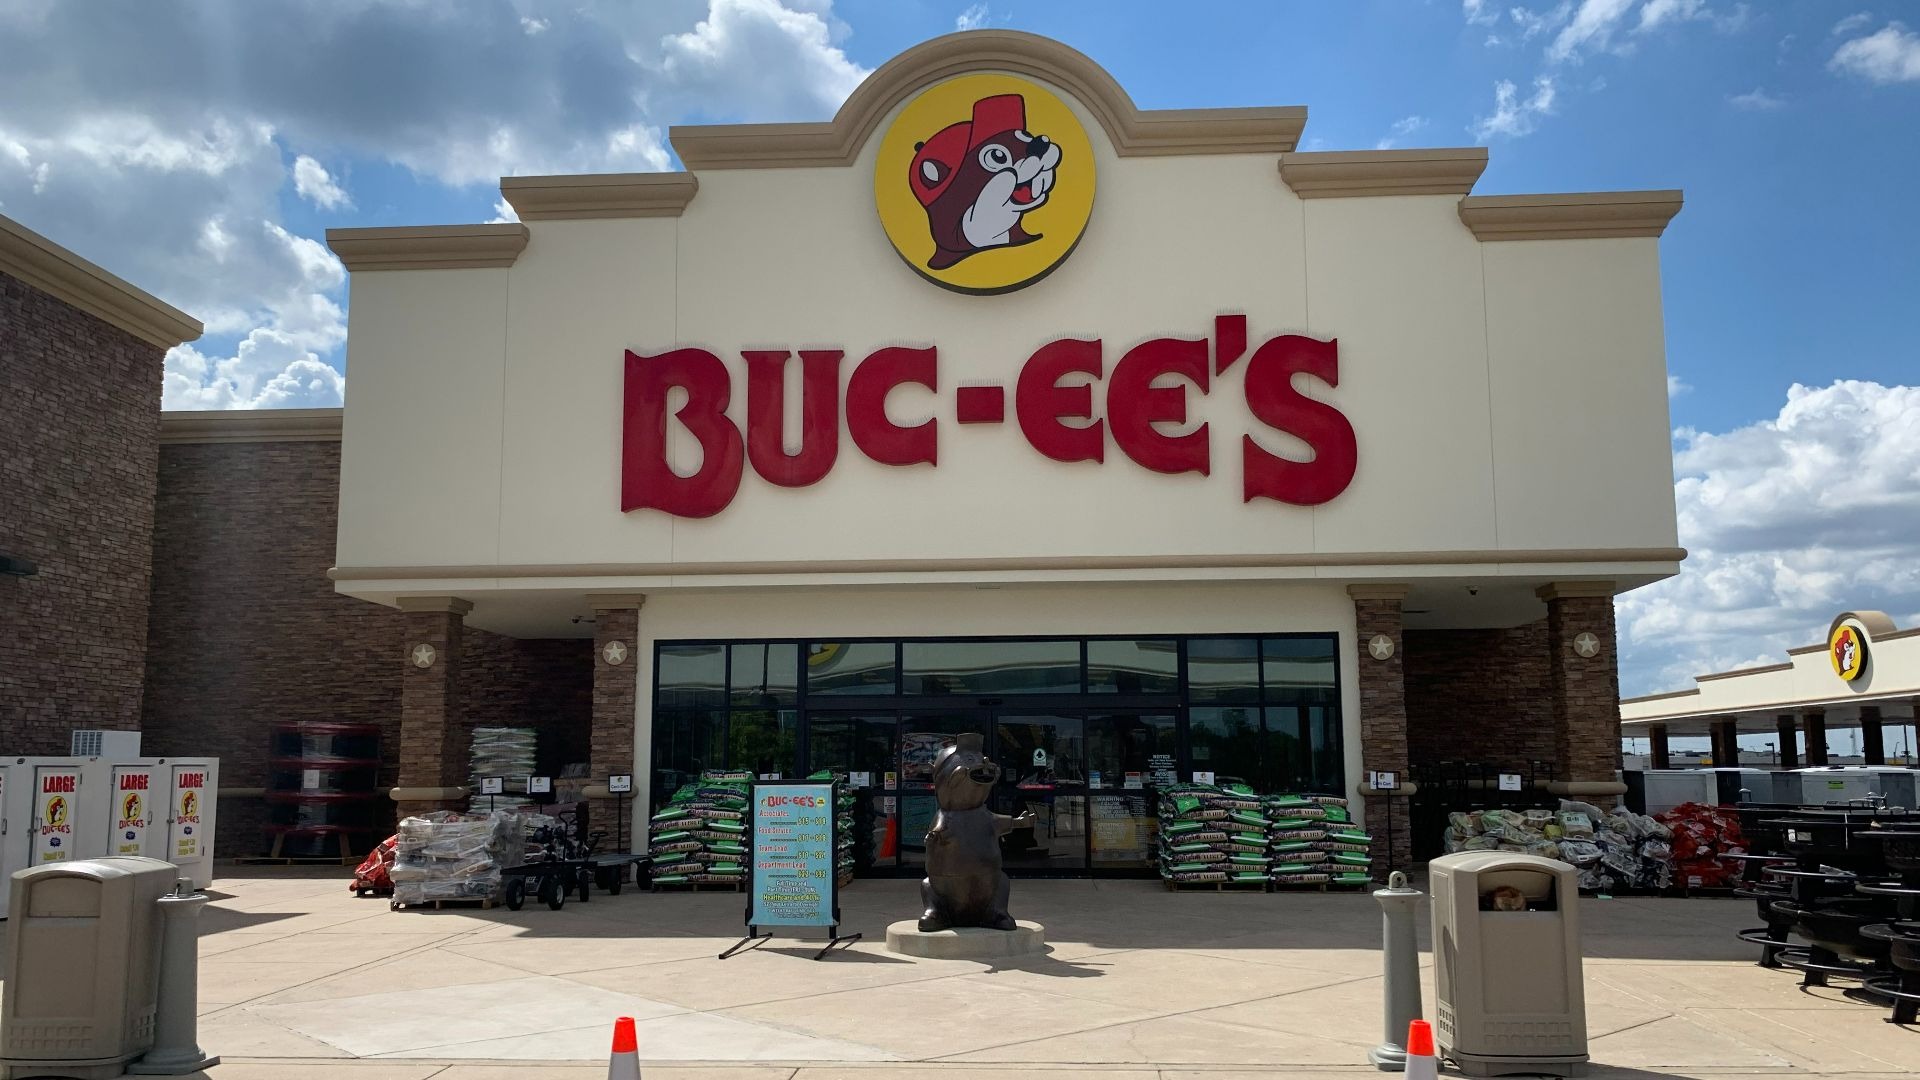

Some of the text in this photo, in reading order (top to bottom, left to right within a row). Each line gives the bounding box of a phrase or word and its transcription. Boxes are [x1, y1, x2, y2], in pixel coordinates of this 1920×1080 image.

[621, 314, 1358, 518] BUC-EE'S
[43, 775, 75, 793] LARGE
[120, 774, 149, 790] LARGE
[178, 773, 204, 788] LARGE
[767, 796, 815, 807] BUC-EE'S
